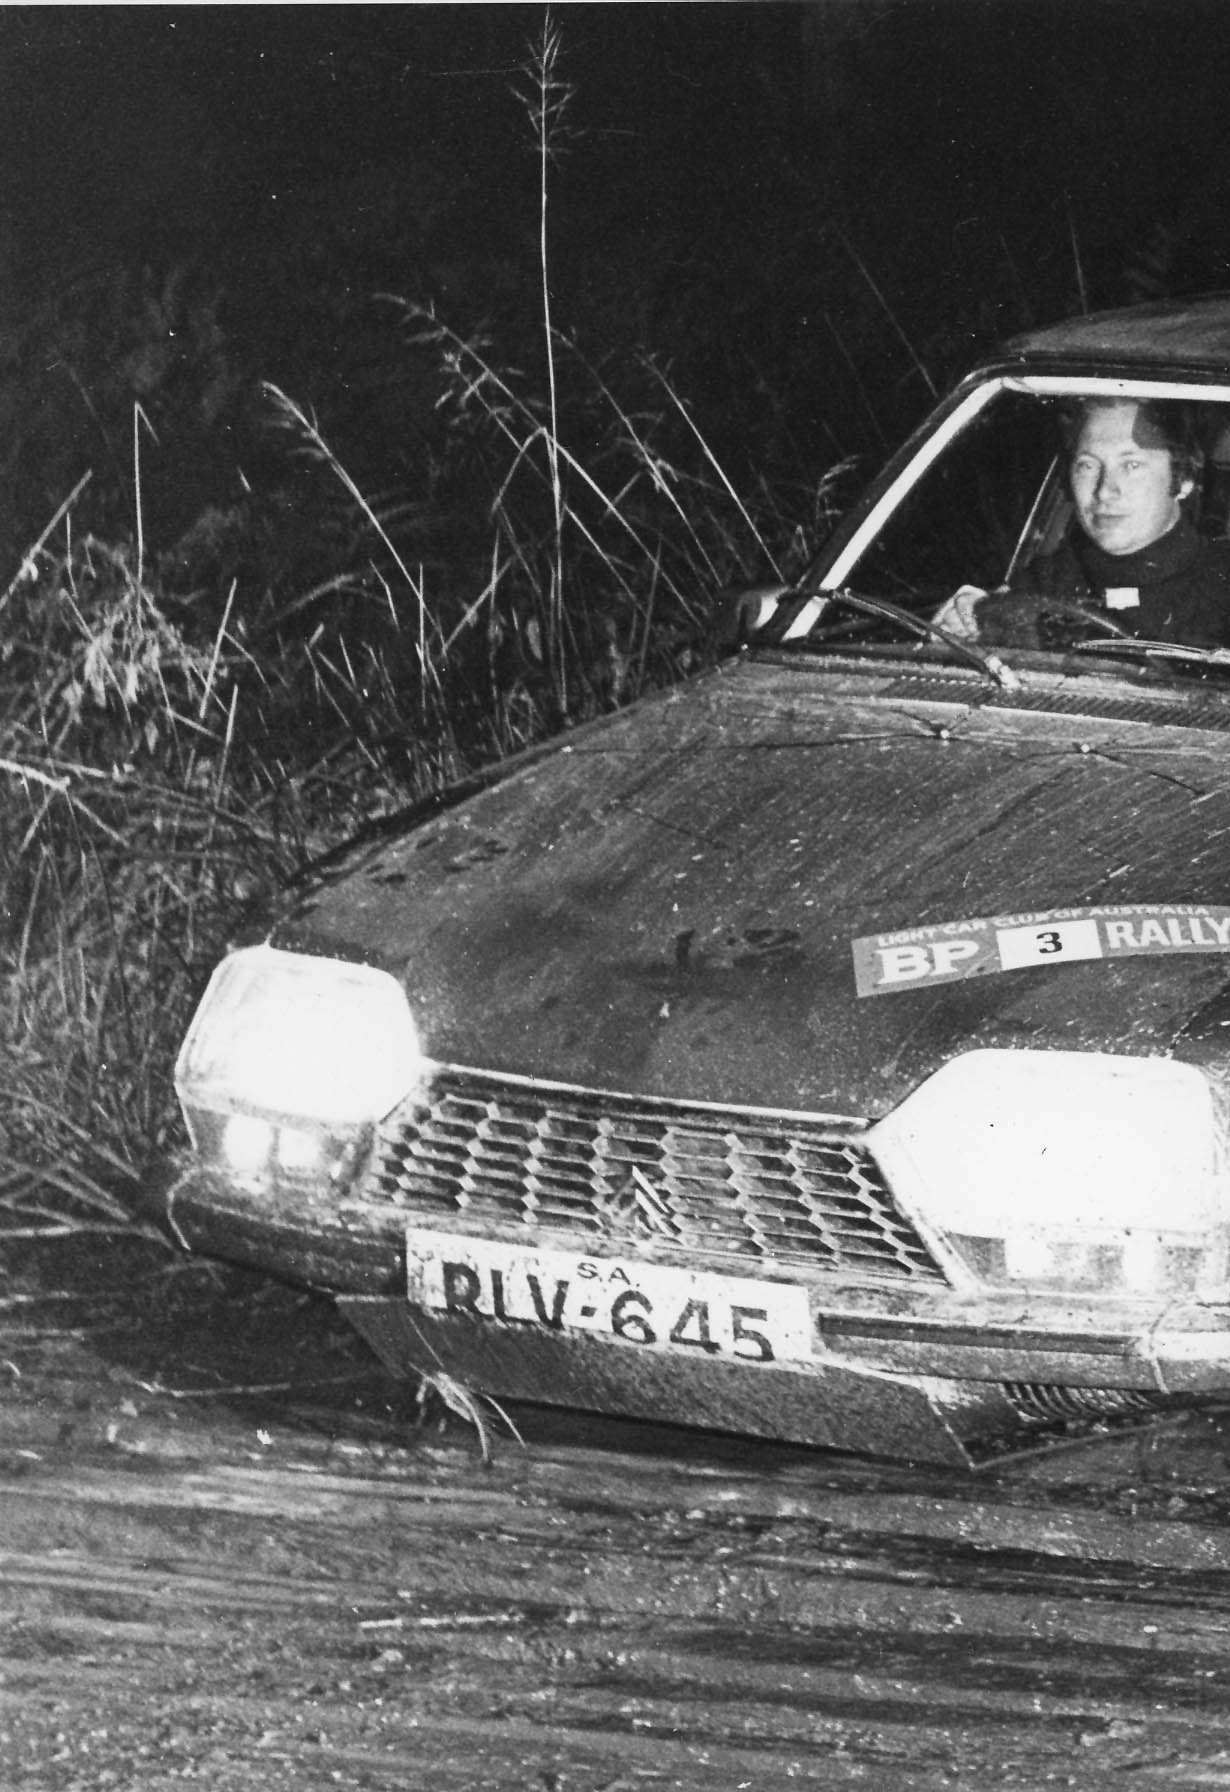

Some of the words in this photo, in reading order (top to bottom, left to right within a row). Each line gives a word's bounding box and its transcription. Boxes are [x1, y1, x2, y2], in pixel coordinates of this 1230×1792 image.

[878, 927, 936, 948] LIGHT
[942, 919, 988, 935] CAR
[1089, 903, 1211, 917] AUSTRALIA
[876, 940, 980, 985] BP
[1036, 932, 1063, 954] 3
